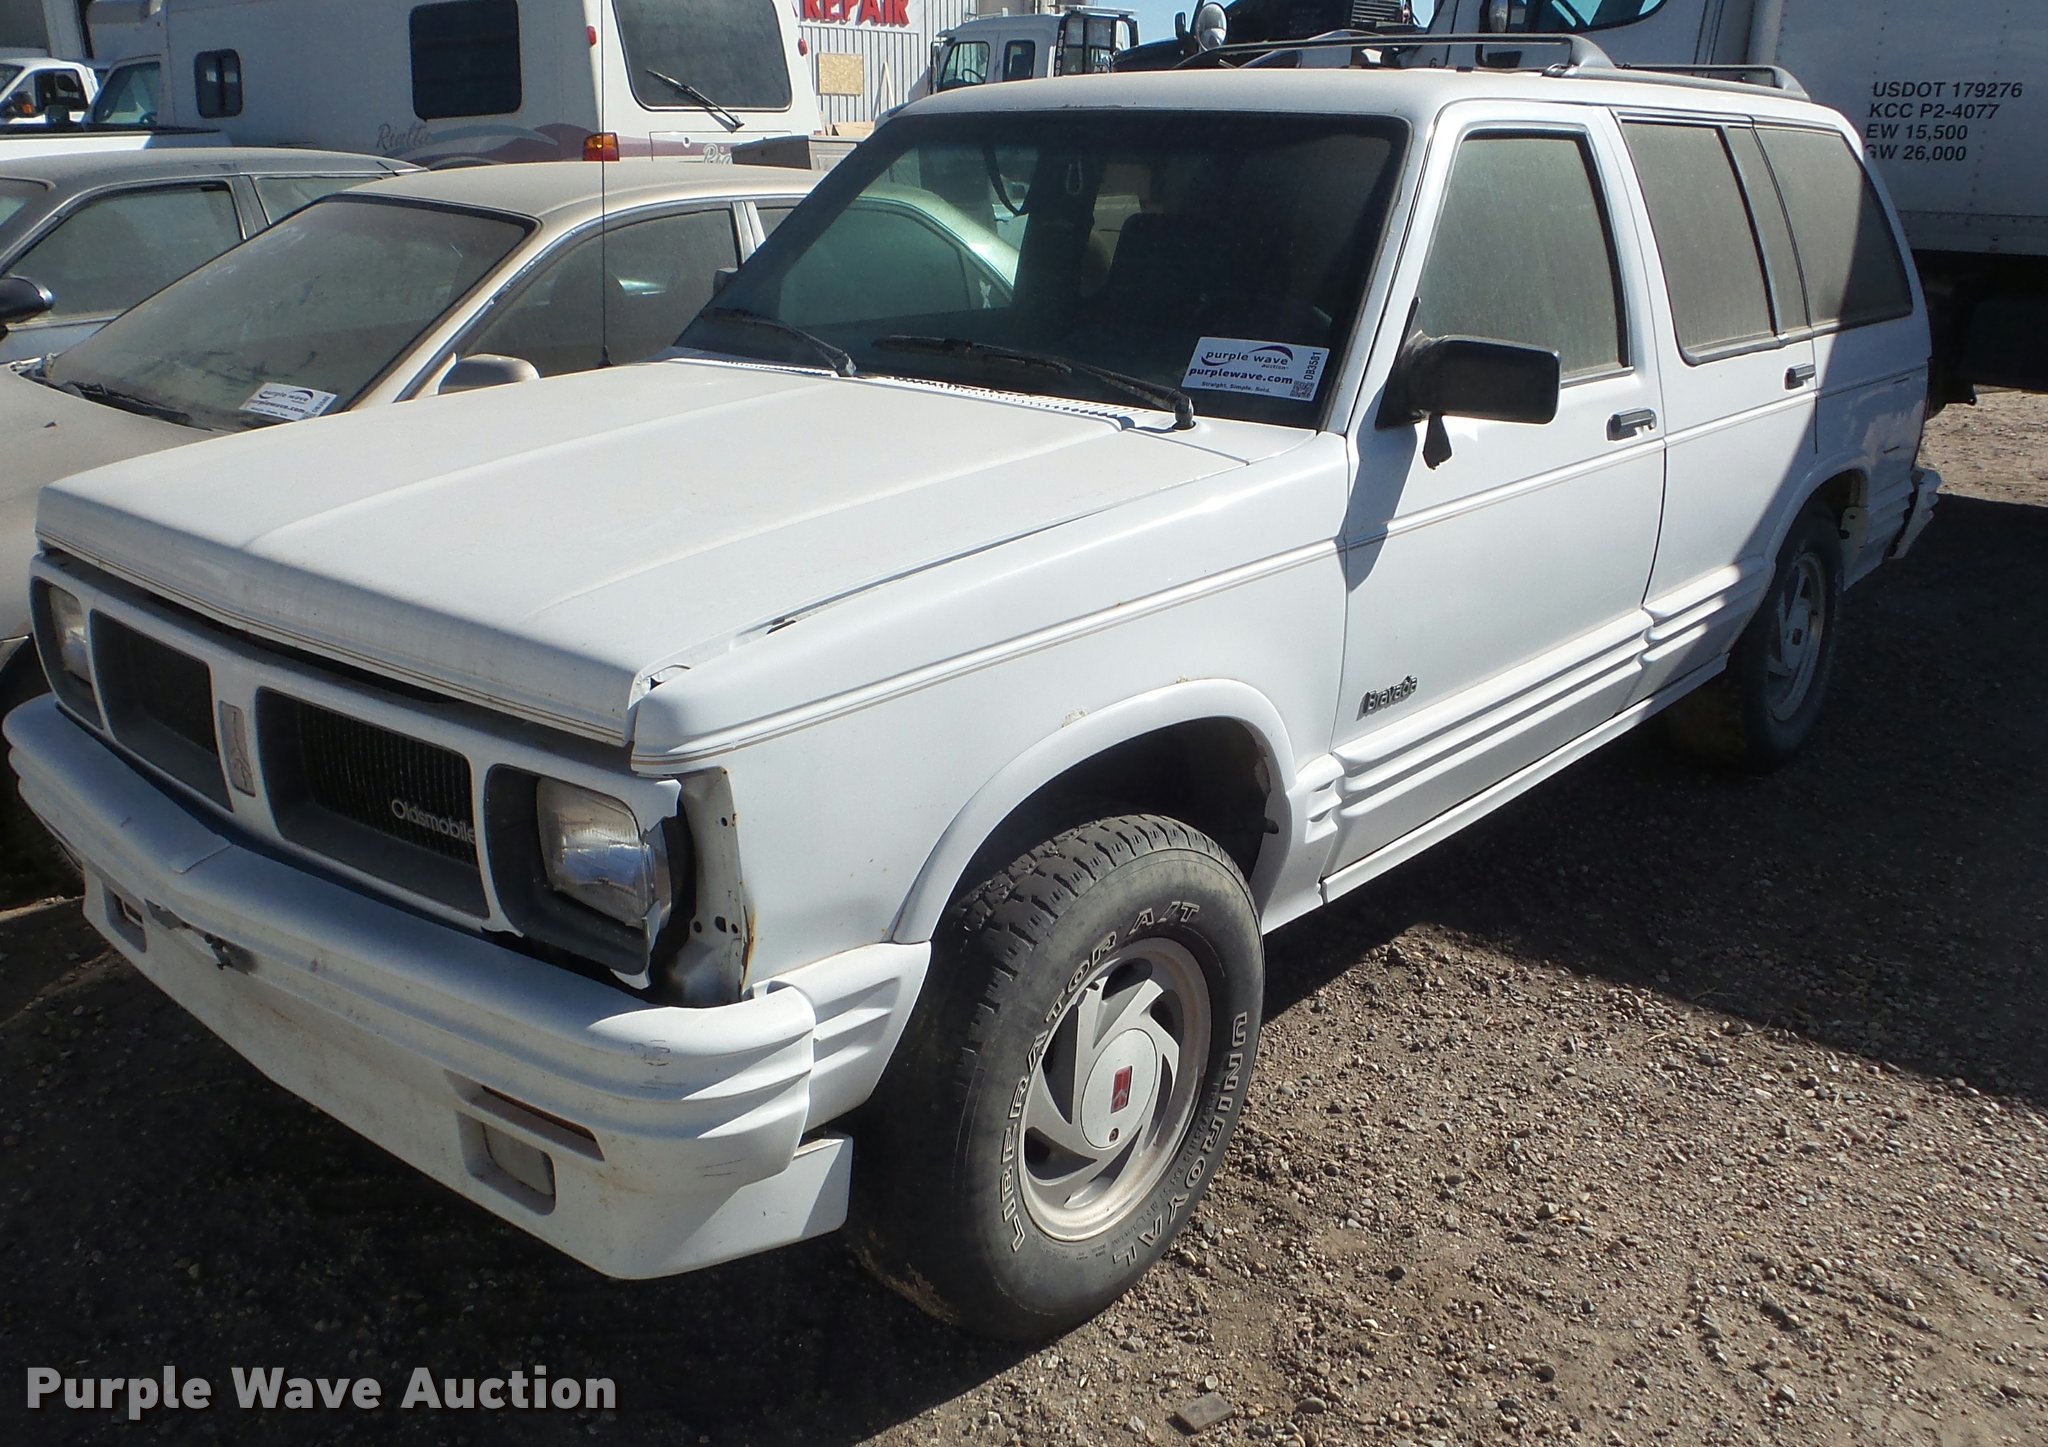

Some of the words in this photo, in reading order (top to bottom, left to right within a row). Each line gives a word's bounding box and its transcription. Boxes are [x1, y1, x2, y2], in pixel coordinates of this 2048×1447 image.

[800, 0, 910, 27] REPAIR
[1873, 82, 1946, 98] USDOT
[1952, 82, 2023, 98] 179276
[1868, 103, 1913, 118] KCC
[1920, 103, 2001, 119] P2-4077
[1865, 124, 1899, 139] EW
[1906, 125, 1968, 141] 15,500
[1903, 145, 1967, 163] 26,000
[1205, 351, 1249, 361] purple
[1253, 355, 1289, 366] wave
[1188, 367, 1293, 385] purplewave.com
[1361, 676, 1418, 714] Bravada
[392, 800, 476, 845] Oldsmobile
[1000, 930, 1117, 1254] LIBERATOR
[1128, 901, 1201, 936] A/T
[1112, 1010, 1248, 1267] UNIROYAL
